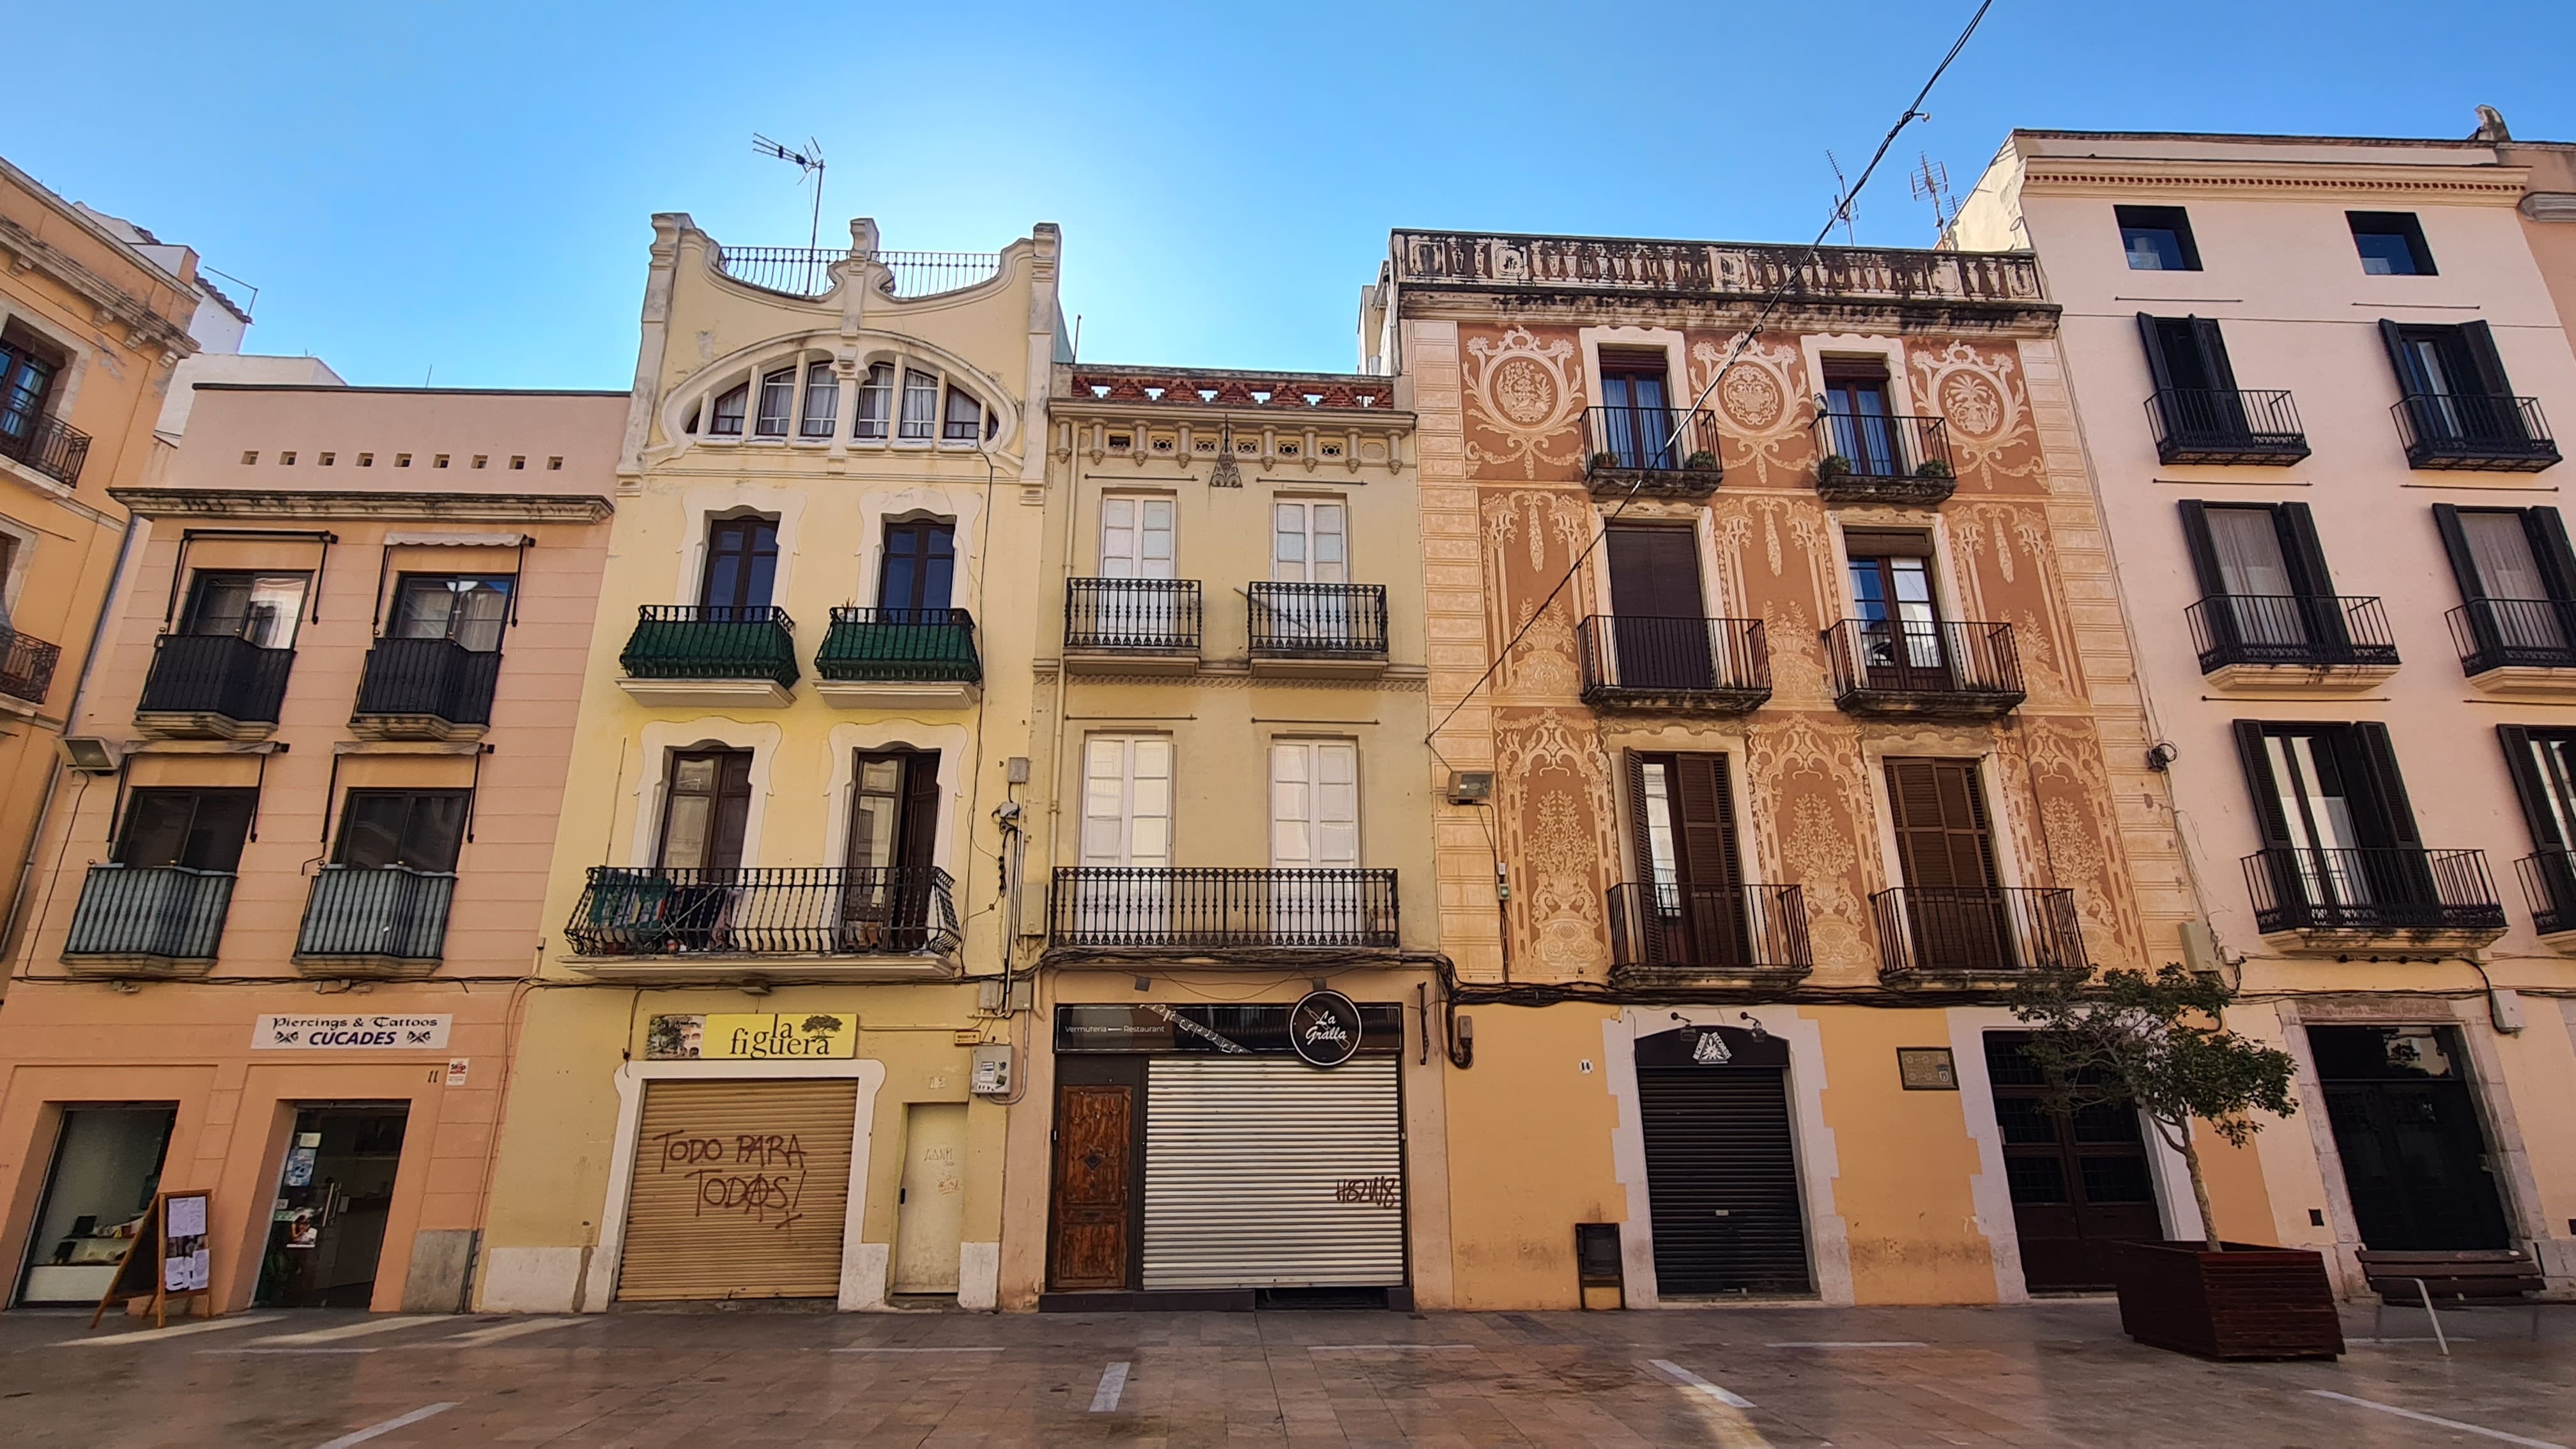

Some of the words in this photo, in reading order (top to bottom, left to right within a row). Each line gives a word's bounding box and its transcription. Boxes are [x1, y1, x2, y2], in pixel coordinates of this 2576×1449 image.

[272, 1017, 348, 1030] Piercings
[353, 1018, 364, 1027] &
[369, 1016, 438, 1027] Tattoos
[772, 1013, 793, 1038] la
[1315, 1010, 1337, 1025] La
[1123, 1025, 1165, 1033] Restaurant
[1306, 1025, 1347, 1045] Gralla
[309, 1031, 397, 1046] CUCADES
[729, 1028, 830, 1059] figuera
[652, 1130, 723, 1173] TODO
[736, 1134, 808, 1168] PARA
